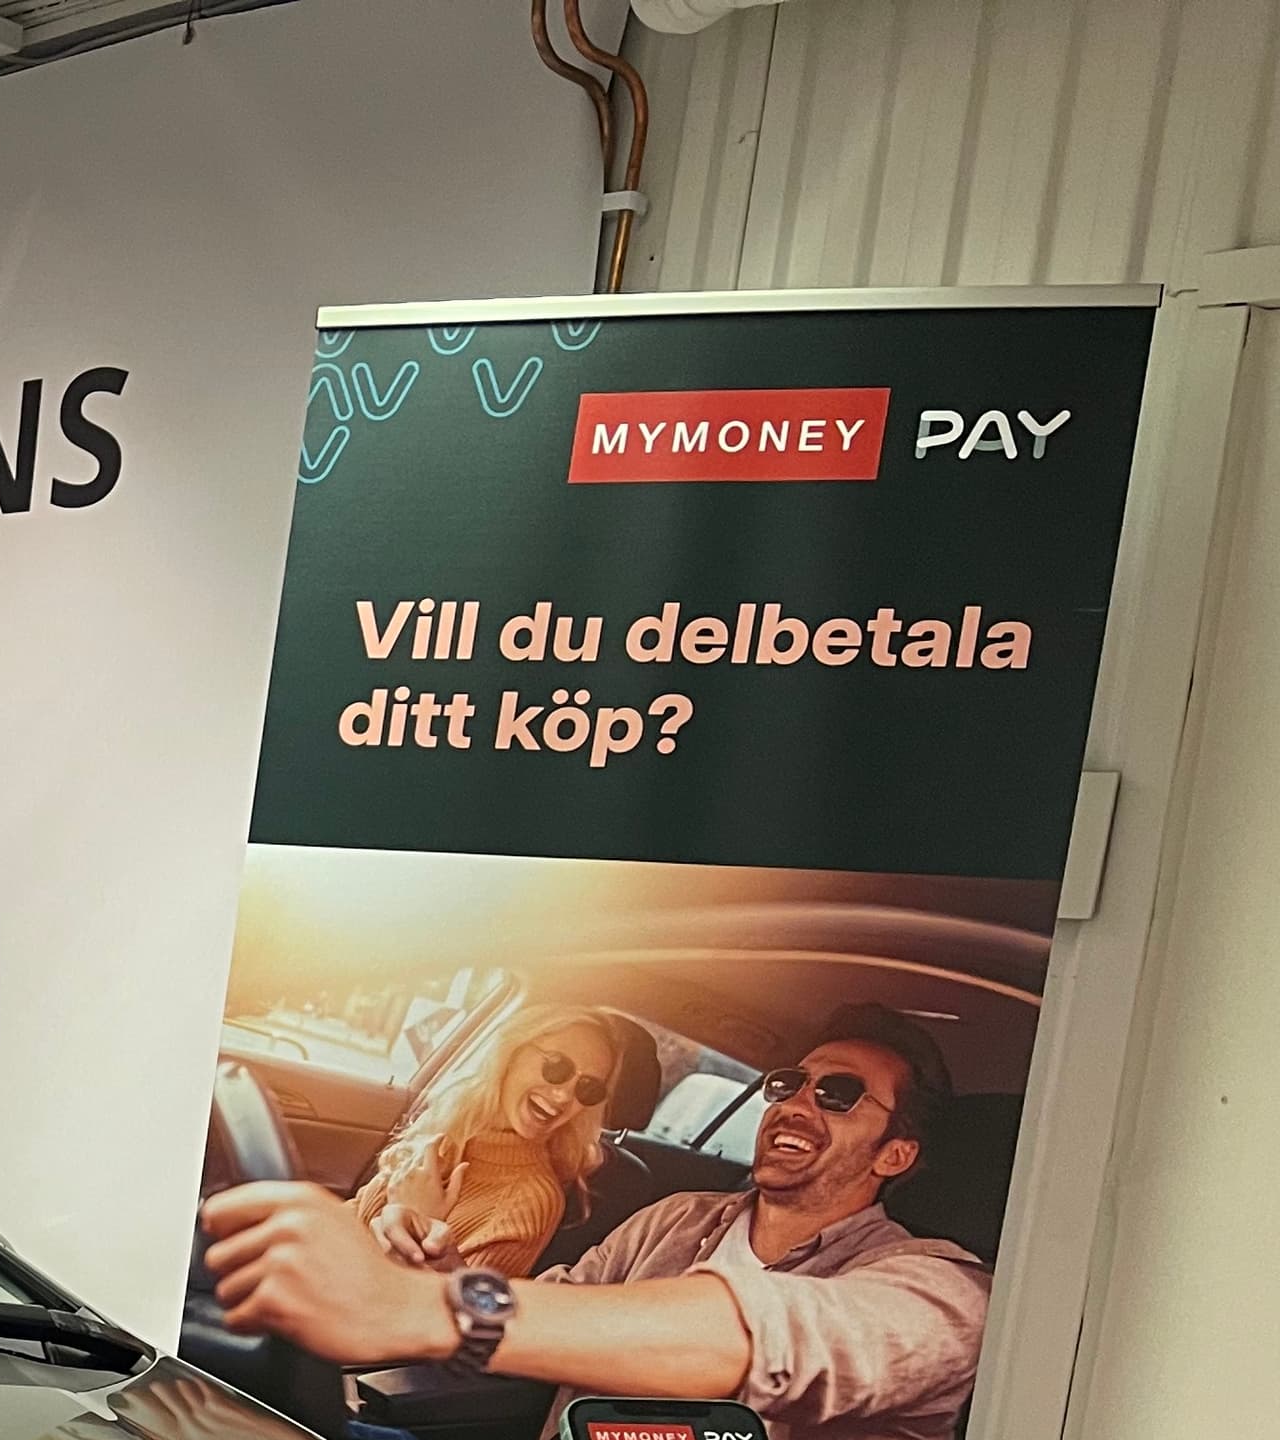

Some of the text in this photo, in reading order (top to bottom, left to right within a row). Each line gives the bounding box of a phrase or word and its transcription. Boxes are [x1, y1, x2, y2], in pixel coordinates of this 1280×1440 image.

[592, 409, 1071, 460] MYMONEY PAY
[357, 598, 1032, 669] Vill du delbetala
[338, 686, 694, 768] ditt köp?
